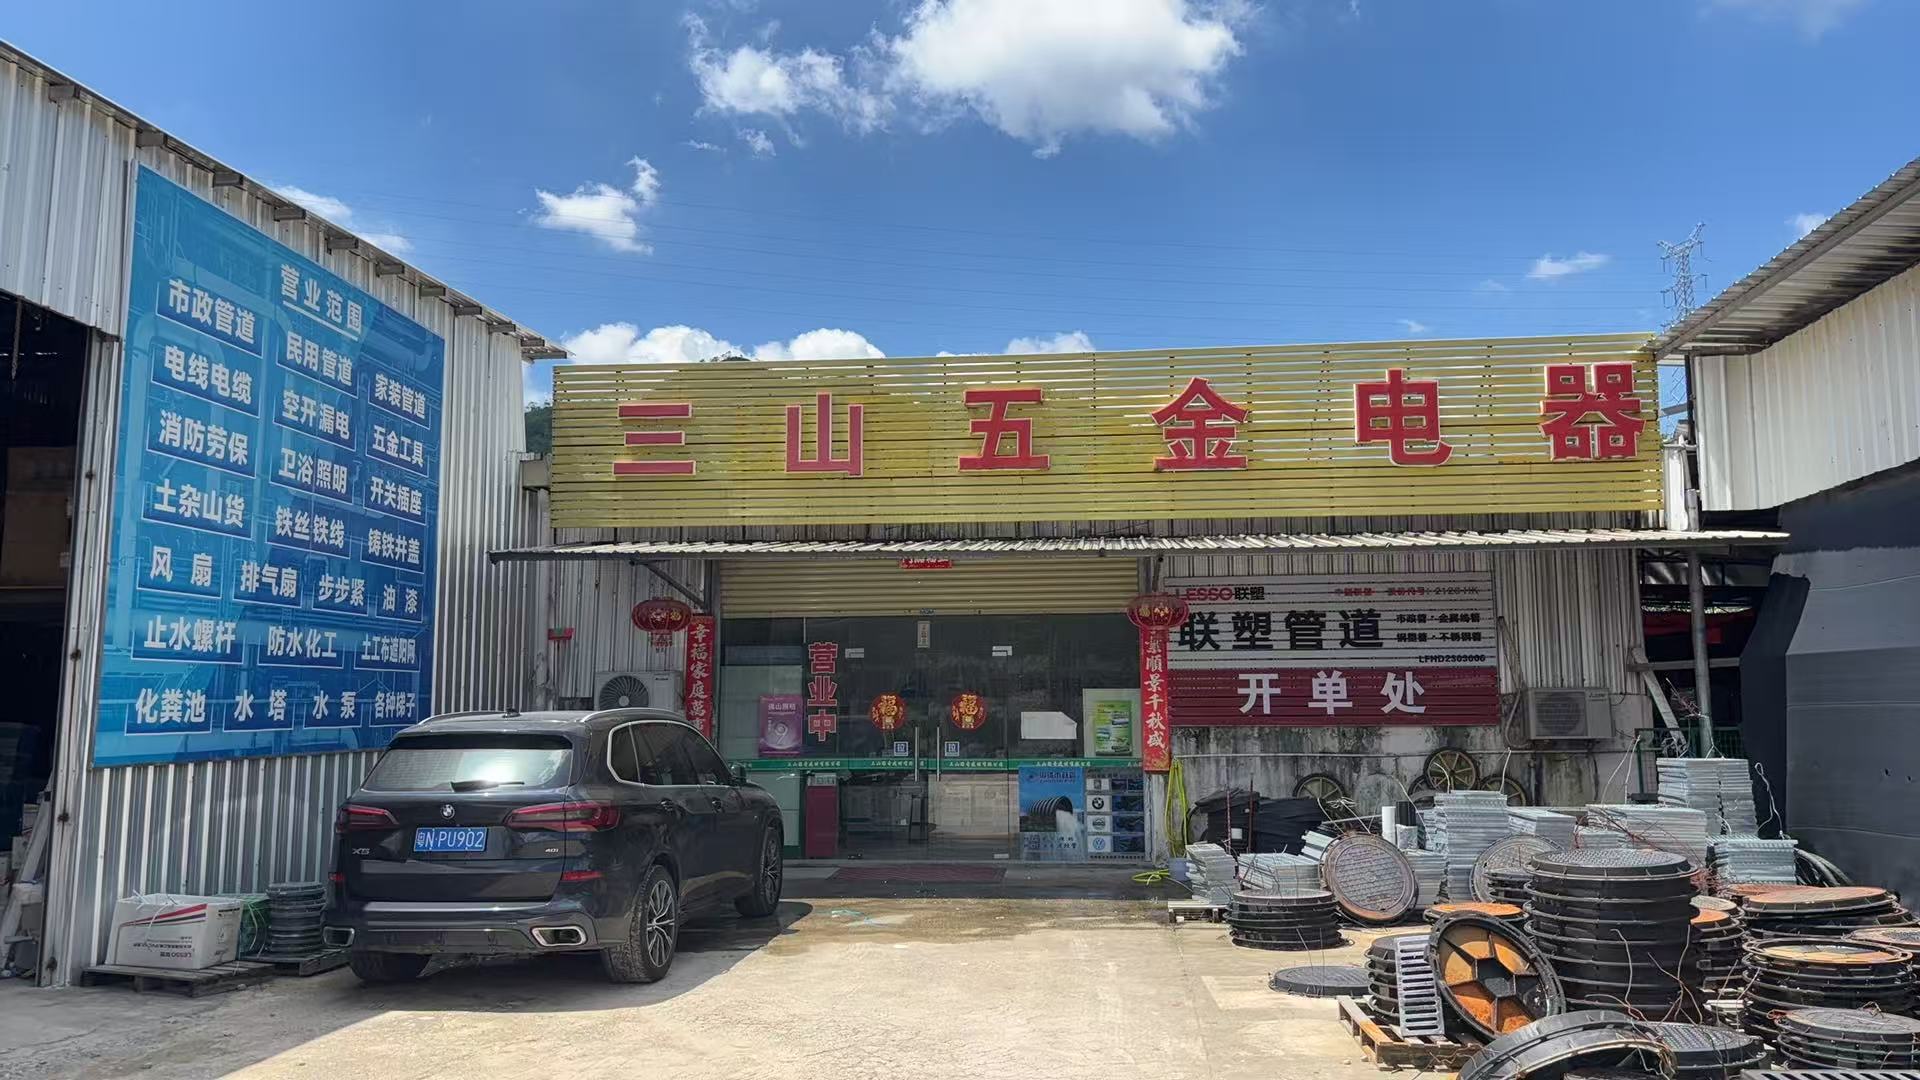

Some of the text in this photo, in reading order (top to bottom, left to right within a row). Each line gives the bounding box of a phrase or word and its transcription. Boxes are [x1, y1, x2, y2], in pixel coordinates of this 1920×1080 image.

[168, 278, 255, 345] 市政管道
[281, 263, 363, 335] 营业范围
[164, 345, 252, 405] 电线电缆
[286, 331, 353, 386] 民用管道
[282, 389, 350, 440] 空开漏电
[375, 373, 426, 419] 家装管道
[159, 409, 248, 466] 消防劳保
[612, 362, 1647, 477] 三山五金电器
[372, 424, 425, 468] 五金工具
[278, 448, 348, 495] 卫浴照明
[153, 479, 246, 529] 土杂山货
[370, 476, 423, 517] 开关插座
[275, 505, 345, 549] 铁丝铁线
[368, 528, 421, 565] 铸铁井盖
[149, 545, 214, 587] 风扇
[240, 560, 298, 598] 排气扇
[318, 574, 365, 607] 步步紧
[383, 584, 418, 614] 油漆
[144, 615, 236, 654] 止水螺杆
[267, 626, 338, 659] 防水化工
[361, 635, 416, 665] 土工布遮阳网
[1178, 608, 1384, 652] 联塑管道
[135, 688, 207, 725] 化粪池
[233, 689, 288, 721] 水塔
[312, 690, 356, 719] 水泵
[374, 691, 416, 720] 各种梯子
[807, 642, 838, 742] 营业中
[1237, 670, 1426, 715] 开单处
